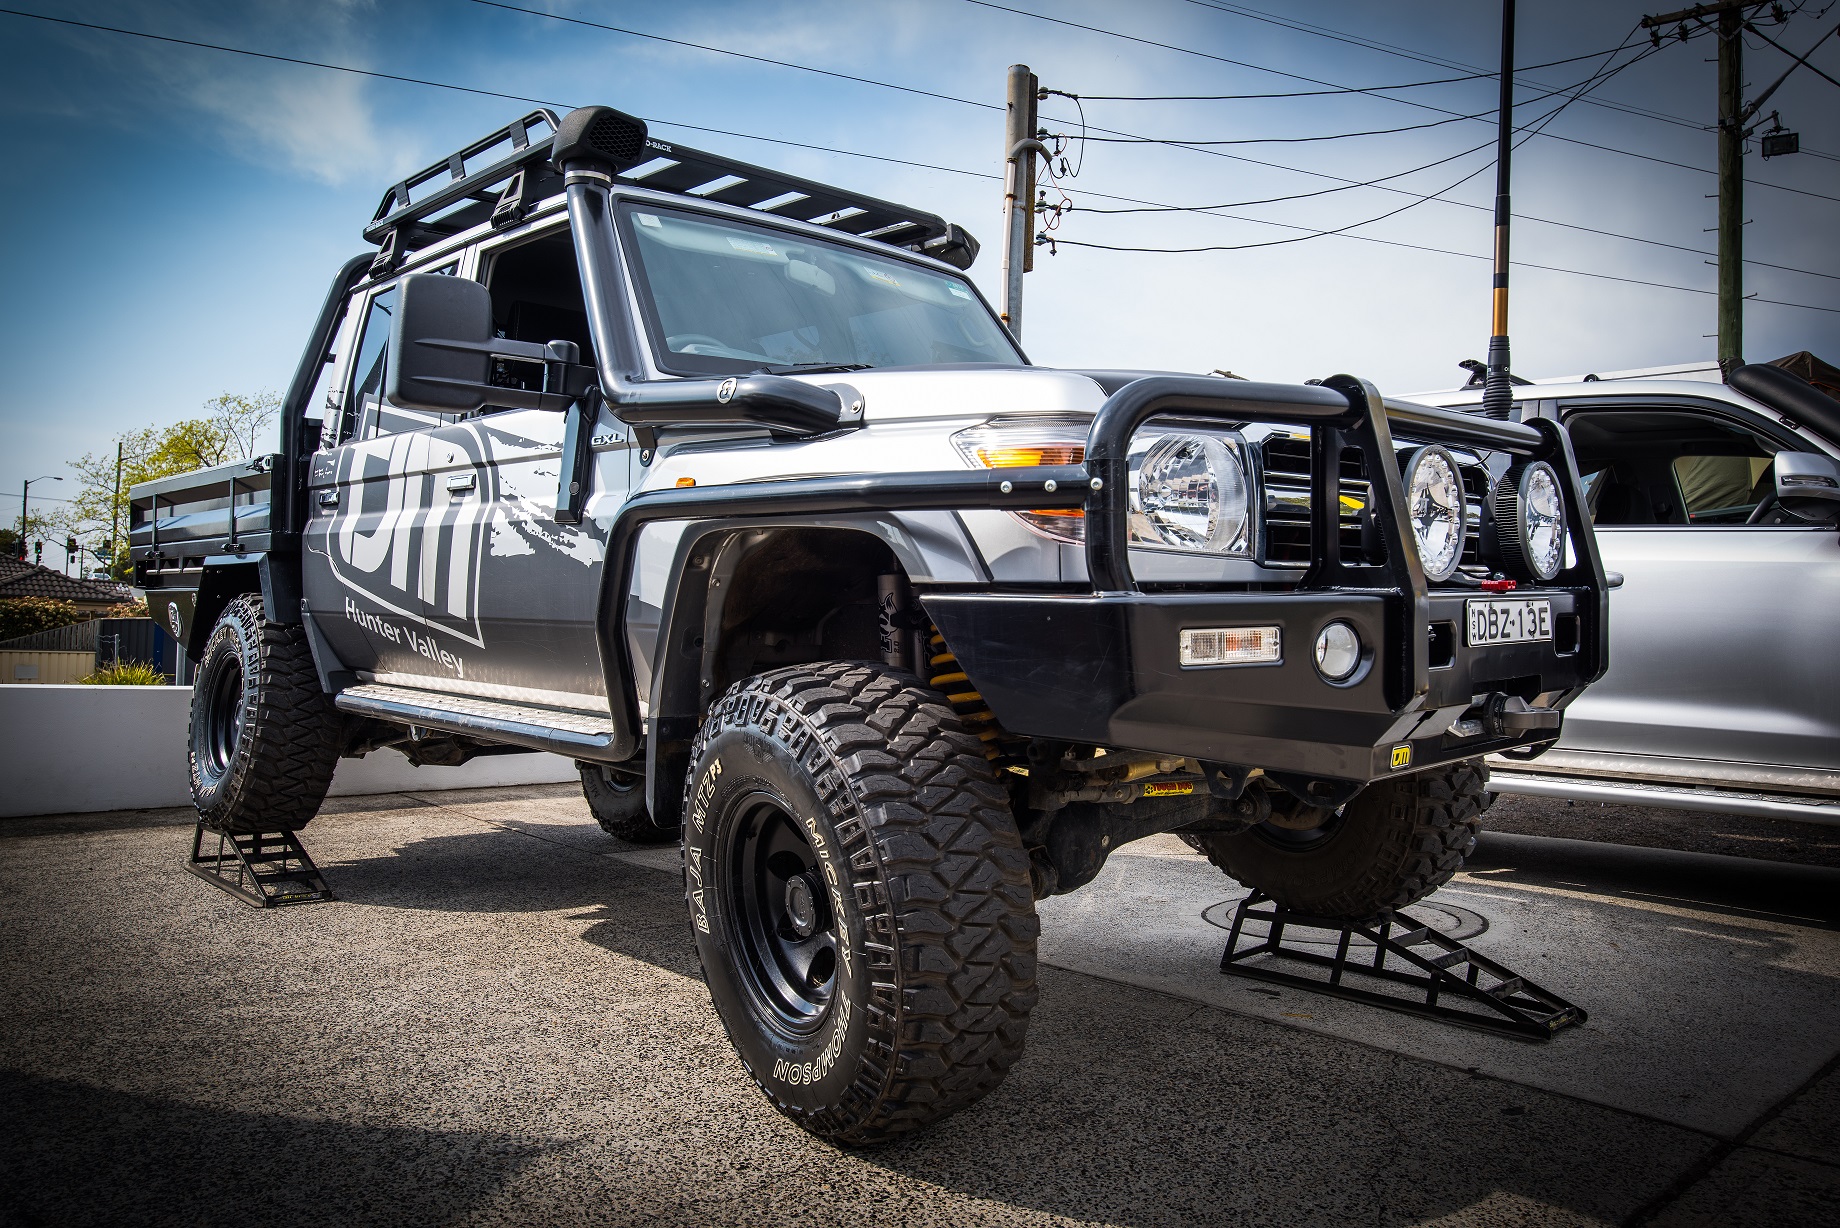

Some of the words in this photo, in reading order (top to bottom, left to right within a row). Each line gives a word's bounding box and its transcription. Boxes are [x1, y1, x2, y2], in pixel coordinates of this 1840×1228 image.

[645, 139, 672, 153] O-RACK
[591, 433, 625, 447] GXL
[345, 595, 401, 645] Hunter
[402, 625, 465, 679] Valley
[688, 845, 711, 935] BAJA
[805, 816, 853, 979] MICKEY
[772, 989, 852, 1086] THOMPSON
